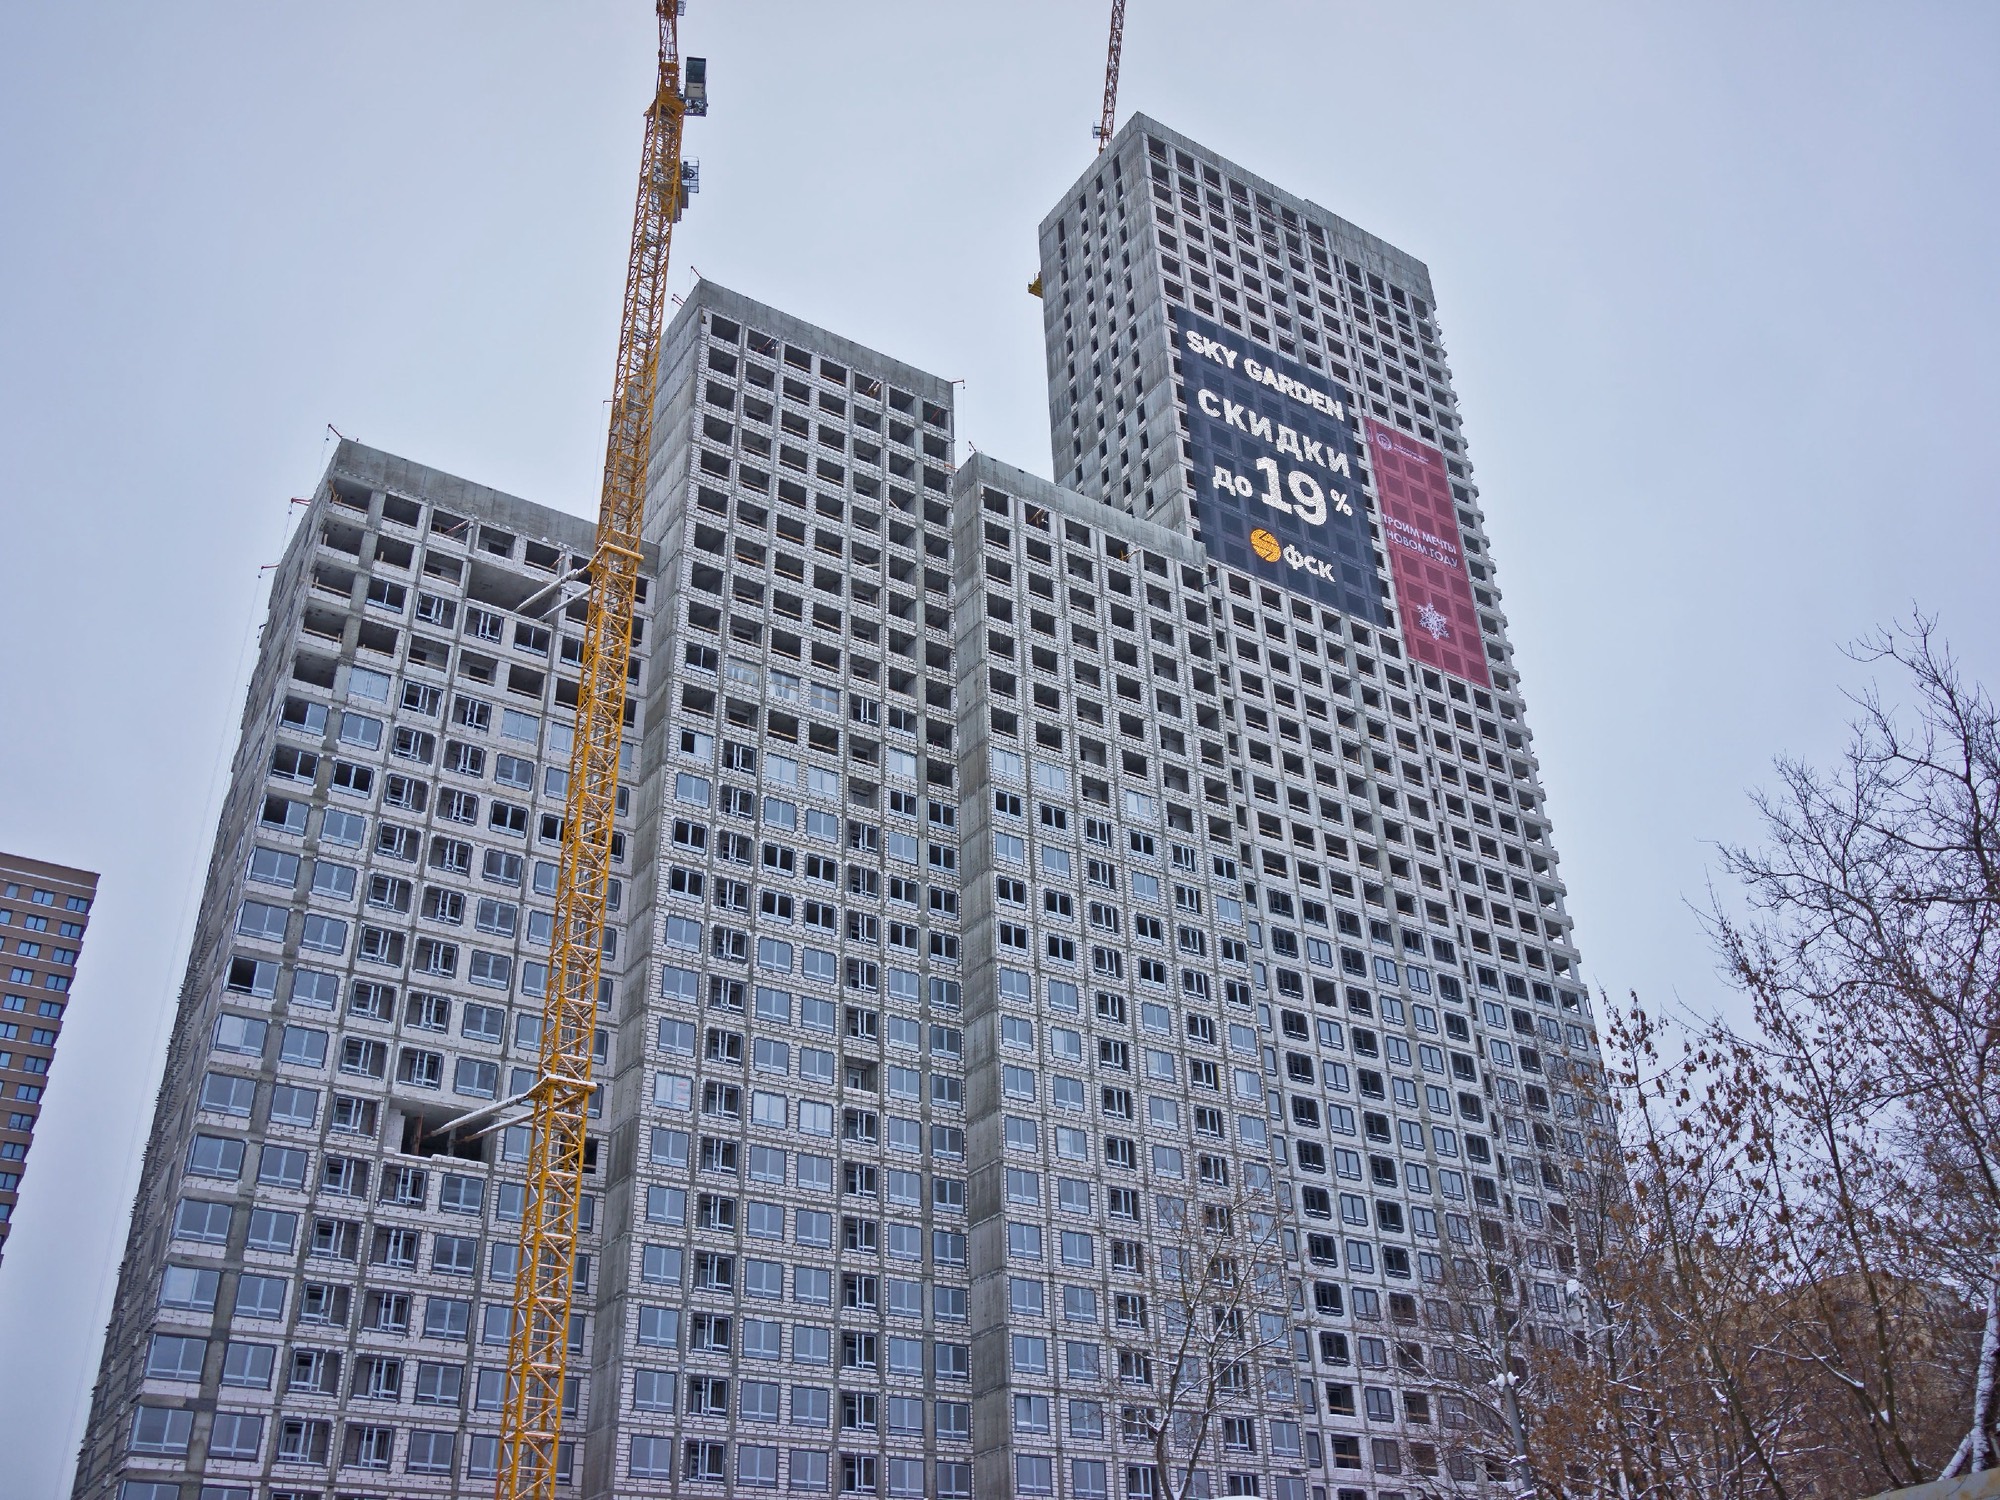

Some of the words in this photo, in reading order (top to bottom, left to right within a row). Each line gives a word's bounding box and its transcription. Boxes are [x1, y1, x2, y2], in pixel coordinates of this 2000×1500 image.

[1186, 330, 1238, 369] SKY
[1243, 358, 1344, 422] GARDEN
[1197, 388, 1351, 479] СКИДКИ
[1386, 528, 1428, 555] НОВОМ
[1430, 548, 1457, 568] ГОДУ
[1422, 531, 1457, 554] МЕЧТЫ
